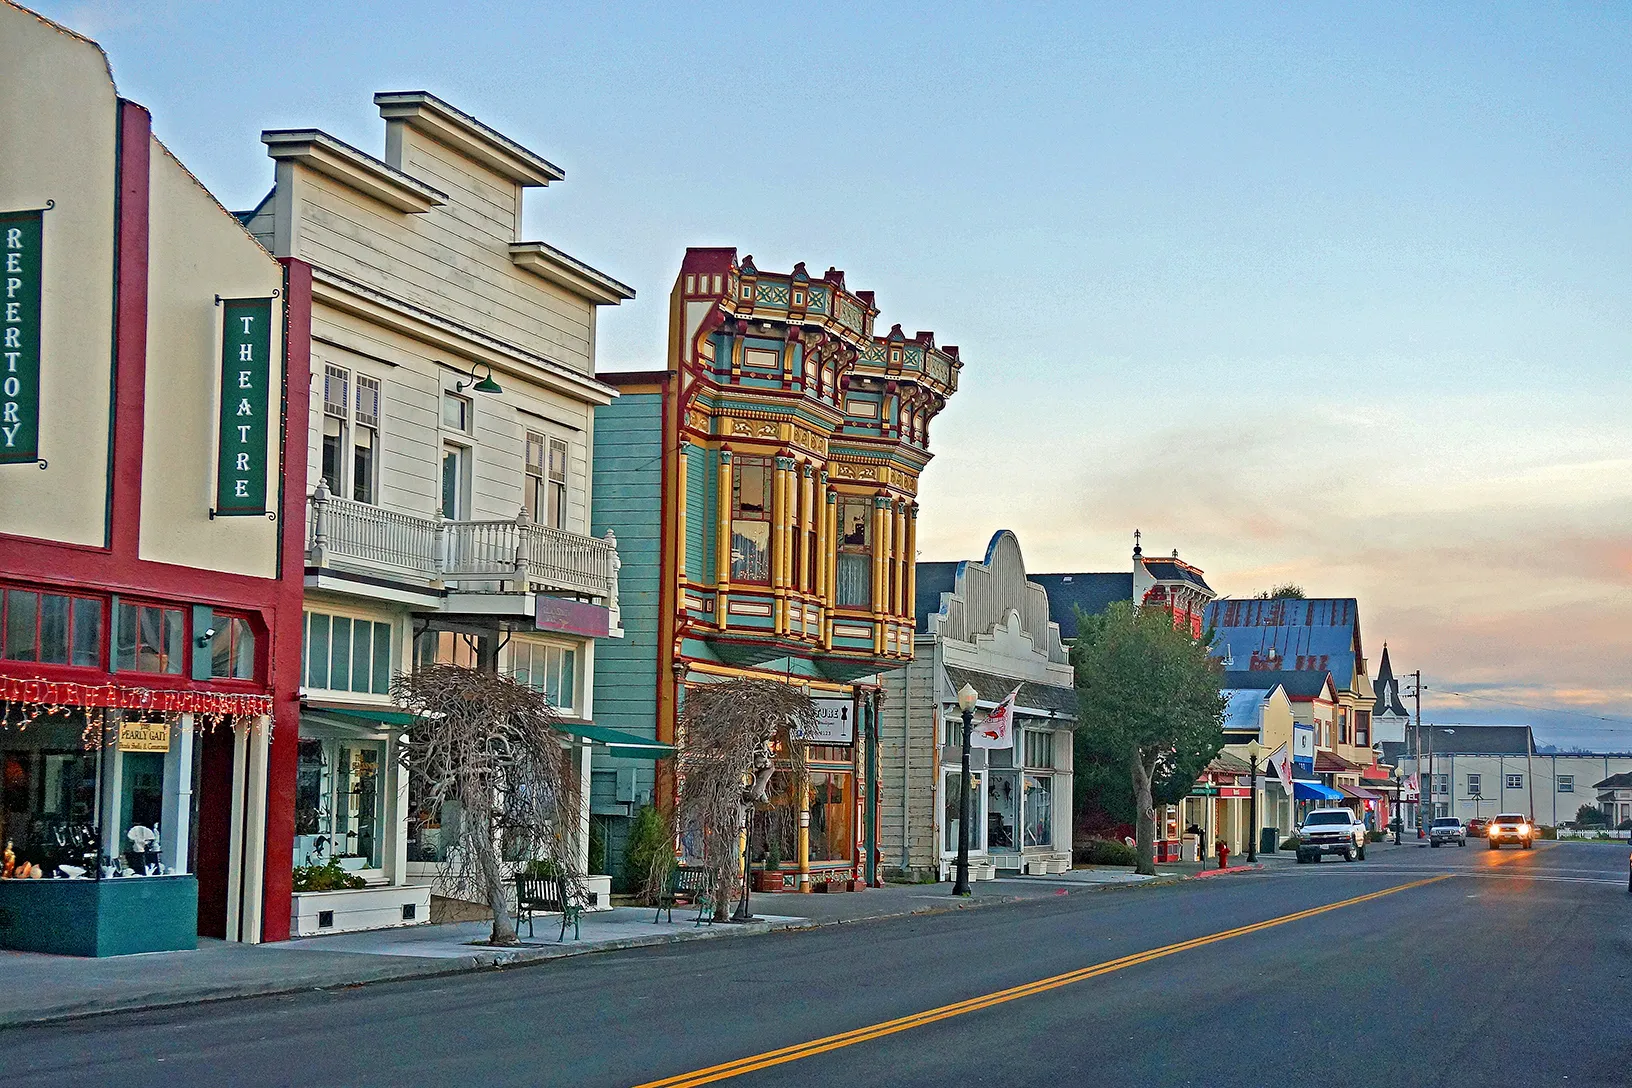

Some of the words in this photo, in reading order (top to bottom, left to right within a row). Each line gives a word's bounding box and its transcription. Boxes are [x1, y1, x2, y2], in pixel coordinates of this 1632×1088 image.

[2, 227, 23, 448] REPERTORY
[234, 316, 254, 498] THEATRE
[121, 730, 147, 740] PEARLY
